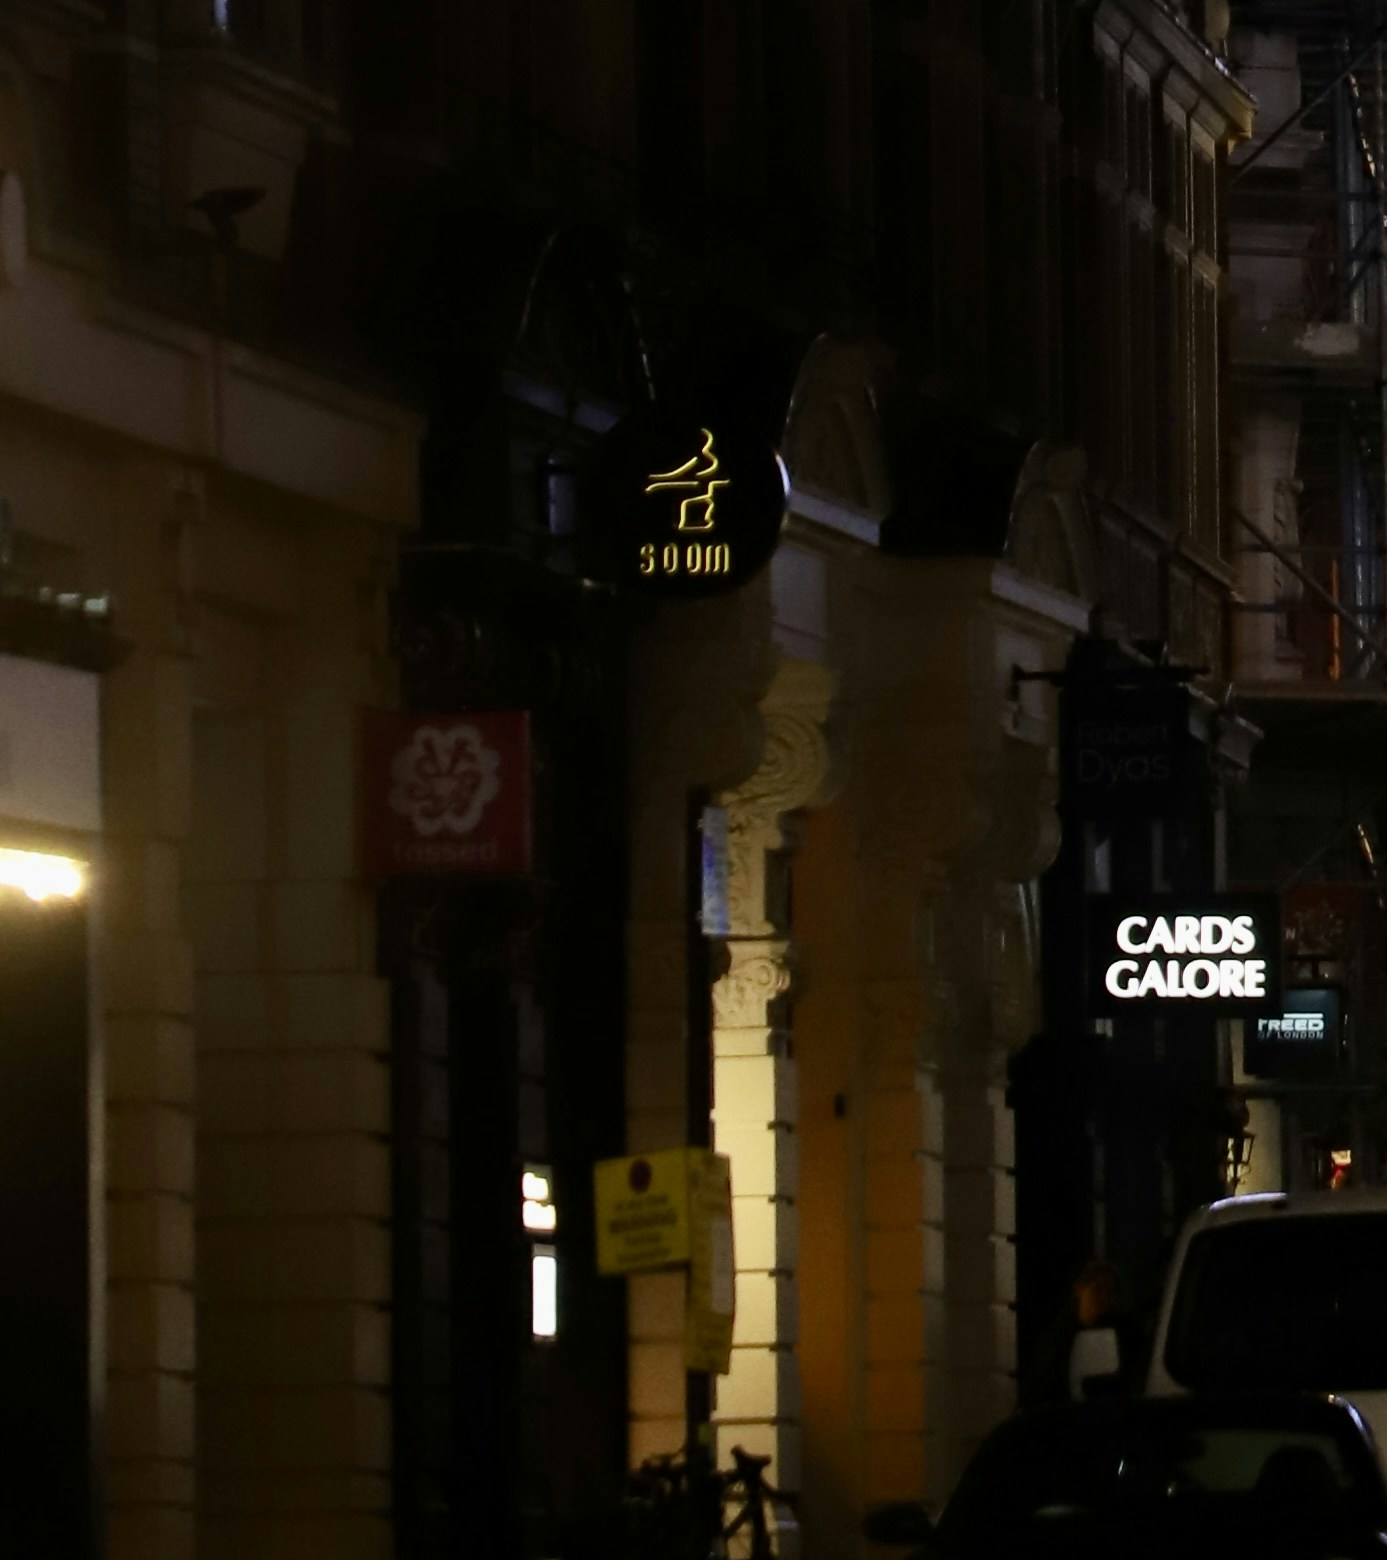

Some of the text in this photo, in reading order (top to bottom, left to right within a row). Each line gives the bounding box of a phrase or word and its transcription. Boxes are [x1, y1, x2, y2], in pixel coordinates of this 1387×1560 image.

[1075, 721, 1171, 745] Robert
[1077, 748, 1172, 791] Dyas
[1115, 914, 1257, 955] CARDS
[1104, 958, 1267, 999] GALORE
[1277, 1030, 1325, 1040] LONDON
